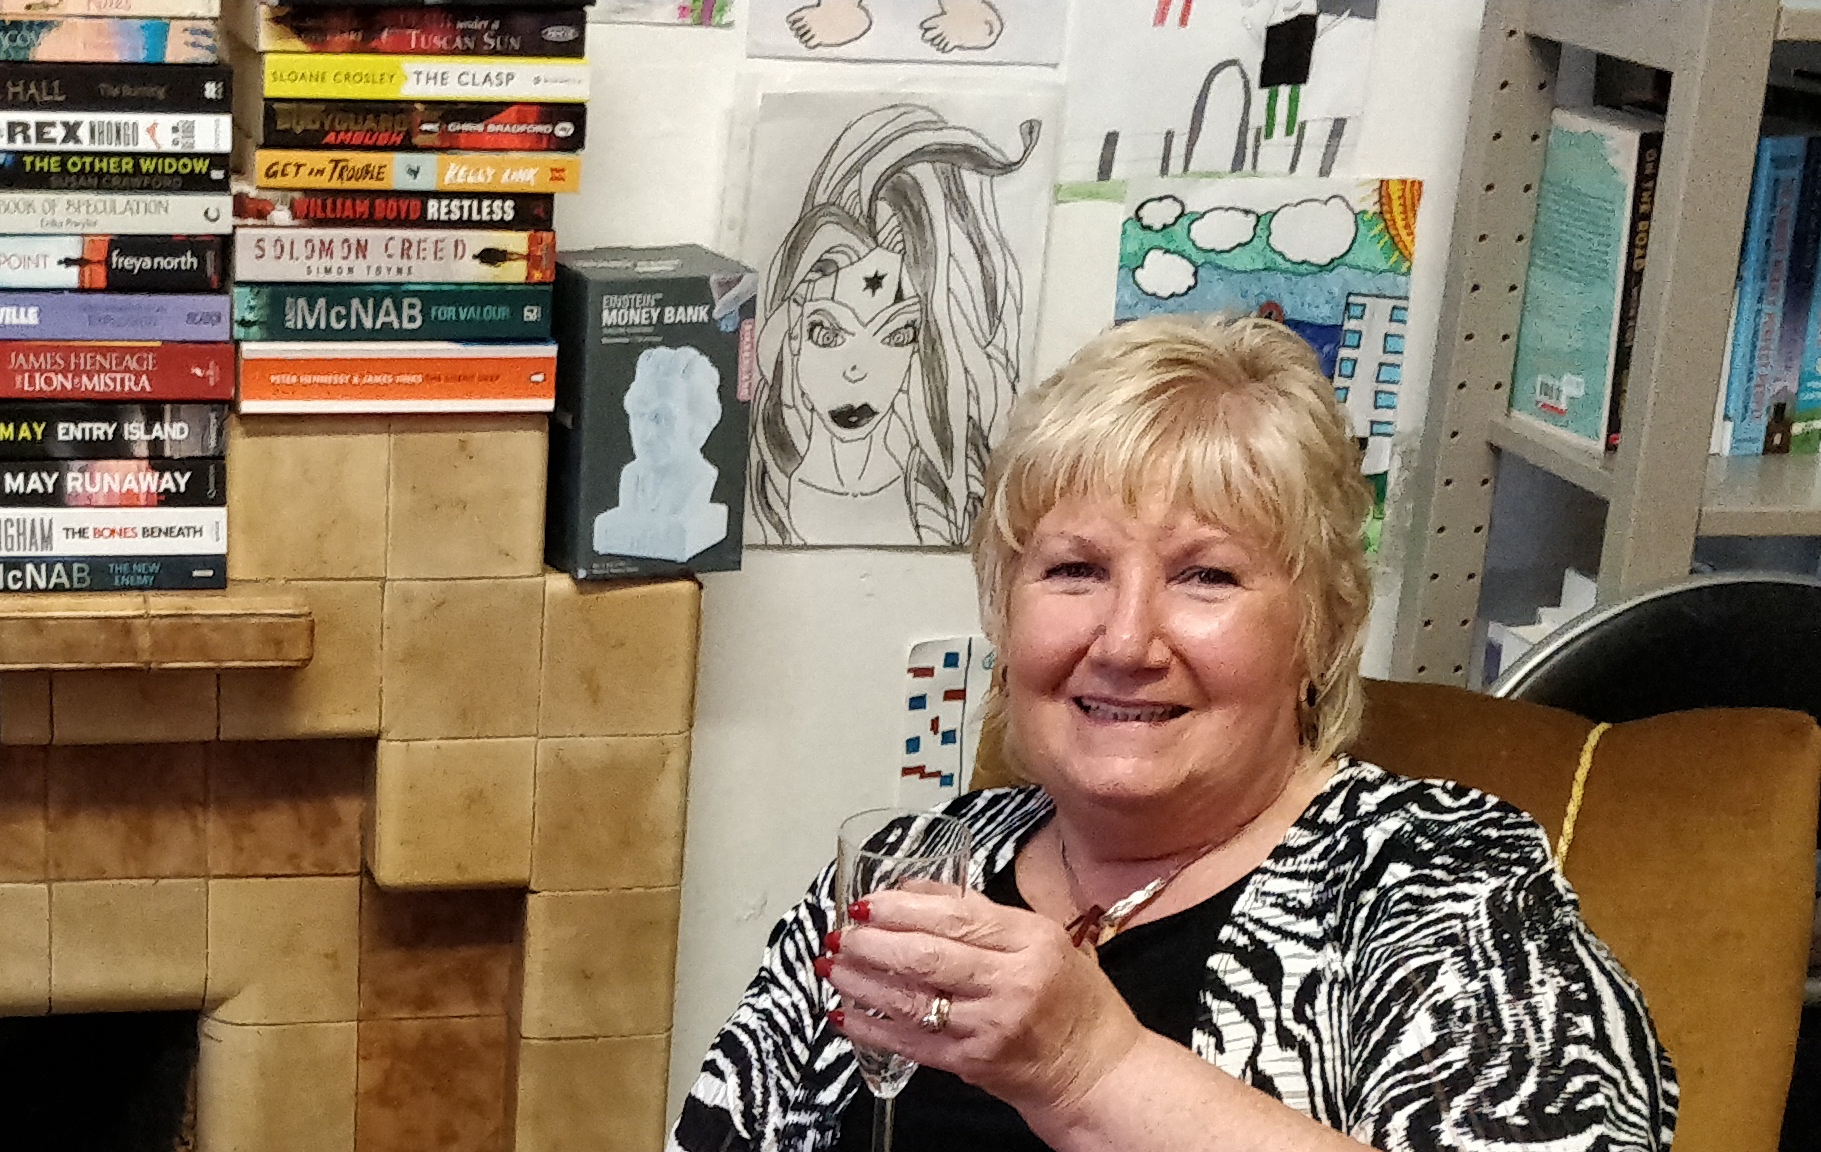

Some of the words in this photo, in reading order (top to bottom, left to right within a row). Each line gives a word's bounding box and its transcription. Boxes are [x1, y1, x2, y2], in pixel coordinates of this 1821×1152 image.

[270, 71, 328, 84] SLOANE
[332, 71, 397, 84] CROSLEY
[413, 70, 449, 86] THE
[457, 71, 516, 87] CLASP
[6, 120, 85, 146] REX
[23, 156, 61, 173] THE
[67, 155, 135, 174] OTHER
[140, 157, 210, 174] WIDOW
[264, 161, 308, 181] GET
[41, 199, 58, 216] OF
[64, 198, 170, 216] SPECULATION
[293, 197, 369, 220] WILLIAM
[374, 198, 422, 220] BOYD
[426, 199, 515, 221] RESTLESS
[254, 237, 368, 261] SOLOMON
[384, 237, 468, 261] CREED
[306, 265, 355, 276] SIMON
[296, 296, 423, 331] McNAB
[430, 304, 457, 321] FOR
[459, 304, 511, 322] VALOUR
[601, 307, 662, 327] MONEY
[663, 305, 711, 325] BANK
[8, 351, 65, 372] JAMES
[69, 352, 158, 372] HENEAGE
[23, 372, 73, 393] LION
[80, 372, 153, 393] MISTRA
[57, 421, 118, 442] ENTRY
[122, 421, 190, 442] ISLAND
[3, 472, 59, 495] MAY
[65, 470, 193, 494] RUNAWAY
[62, 526, 90, 541] THE
[93, 525, 139, 540] BONES
[141, 525, 204, 540] BENEATH
[107, 562, 129, 576] THE
[131, 562, 161, 575] NEW
